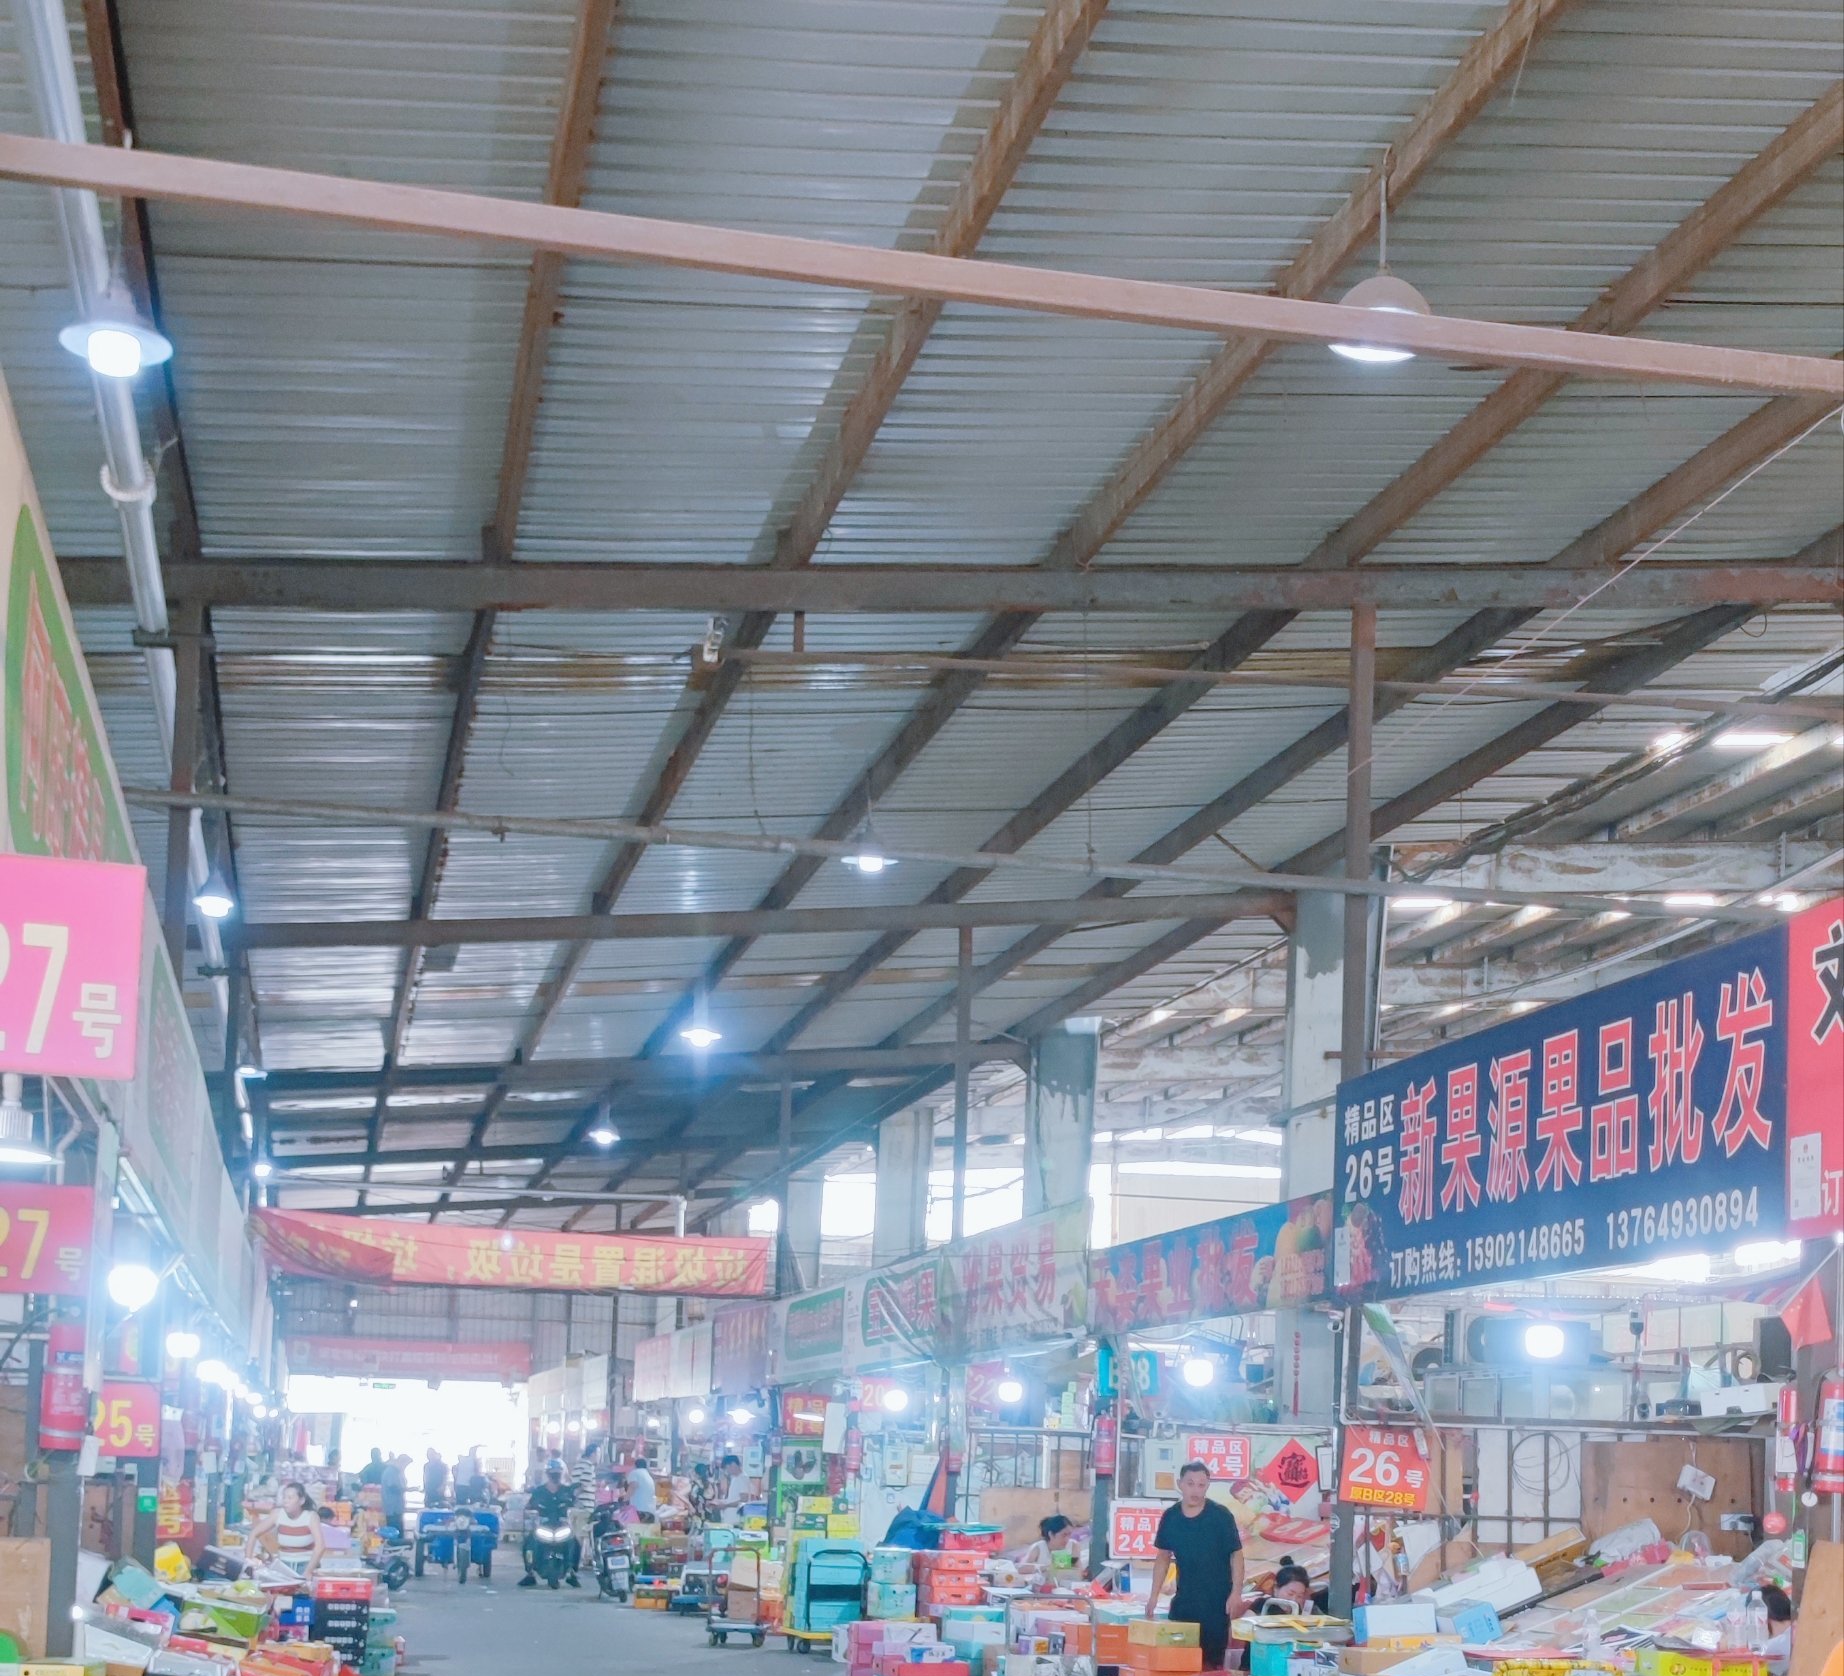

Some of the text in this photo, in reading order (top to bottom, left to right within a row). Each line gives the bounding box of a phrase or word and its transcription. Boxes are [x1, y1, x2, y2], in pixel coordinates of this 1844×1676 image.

[0, 918, 122, 1059] 7号
[1344, 1094, 1395, 1147] 精品区
[1398, 966, 1774, 1226] 新果源果品批发
[1344, 1144, 1395, 1203] 26号
[0, 1209, 84, 1281] 7号
[1466, 1218, 1585, 1273] 15902148665
[1606, 1186, 1759, 1251] 13764930894
[1193, 1456, 1244, 1477] 4号
[1194, 1439, 1244, 1455] 精品区
[1348, 1447, 1424, 1489] 26号
[1118, 1534, 1160, 1552] 24
[1120, 1515, 1162, 1531] 精品
